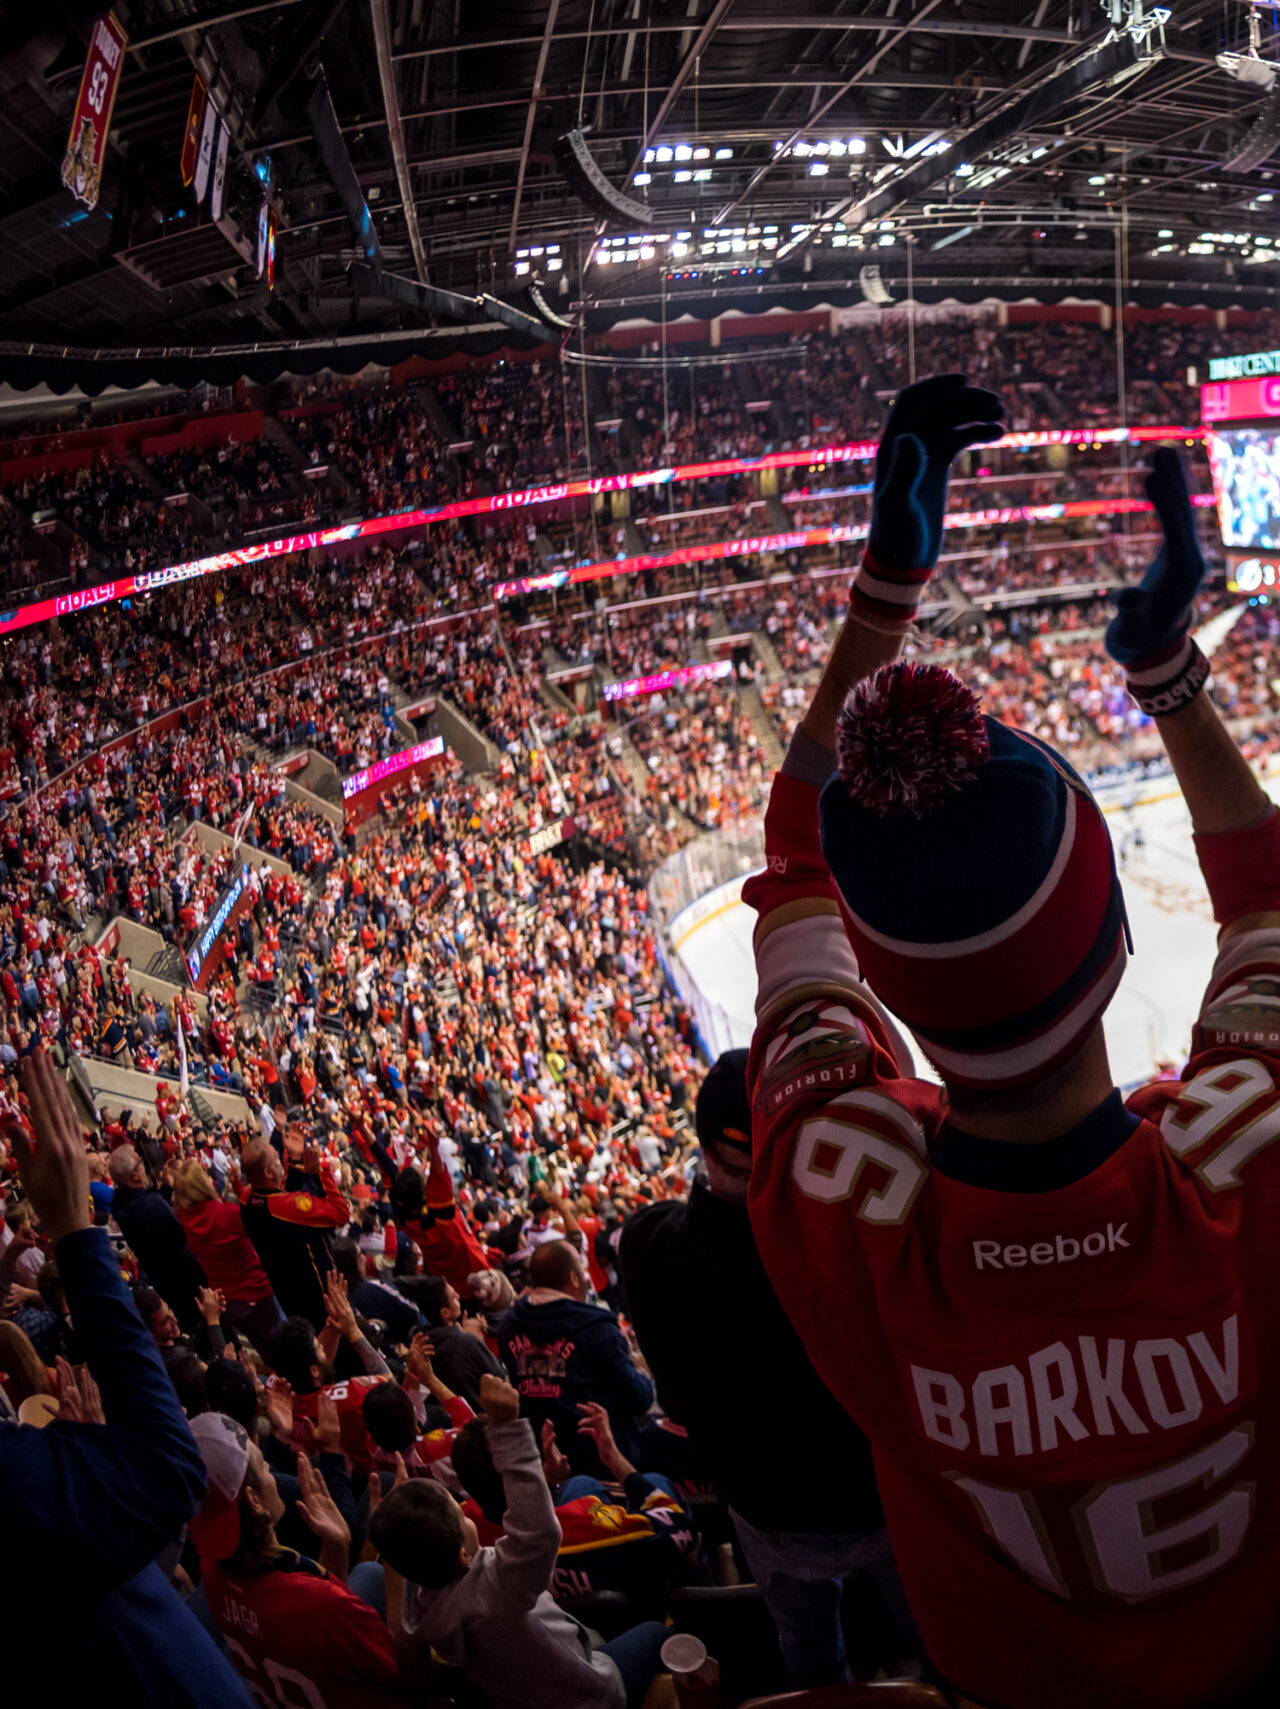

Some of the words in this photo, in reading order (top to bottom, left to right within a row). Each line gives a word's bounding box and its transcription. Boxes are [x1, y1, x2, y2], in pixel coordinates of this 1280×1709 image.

[88, 61, 109, 115] 93
[55, 582, 116, 616] GOAL!
[773, 1062, 857, 1105] FLORIDA
[972, 1221, 1131, 1271] Reebok
[910, 1312, 1239, 1457] BARKOV
[938, 1420, 1257, 1604] 16
